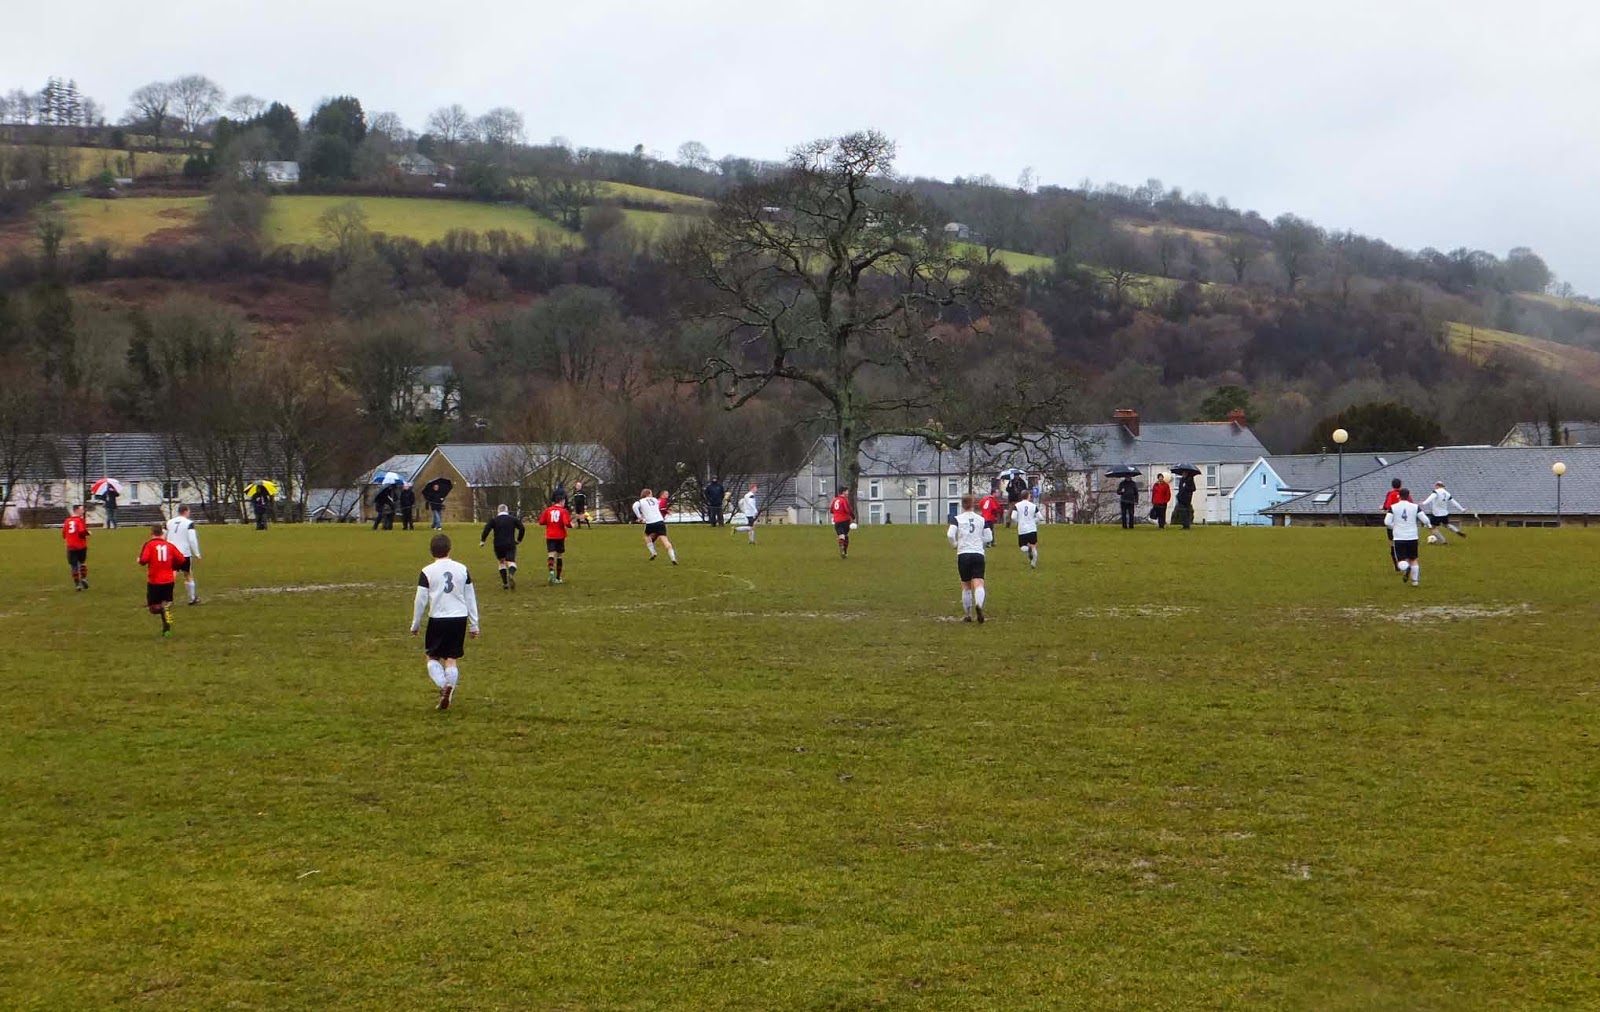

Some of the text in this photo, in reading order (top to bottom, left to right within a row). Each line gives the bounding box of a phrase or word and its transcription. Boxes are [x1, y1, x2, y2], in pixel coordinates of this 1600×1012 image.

[834, 499, 840, 510] 6
[983, 499, 990, 510] 8
[550, 510, 560, 523] 10
[1023, 505, 1029, 517] 8
[1401, 508, 1408, 521] 4
[68, 521, 76, 533] 3
[174, 522, 181, 533] 7
[968, 518, 975, 533] 5
[156, 544, 168, 561] 11
[443, 571, 454, 593] 3
